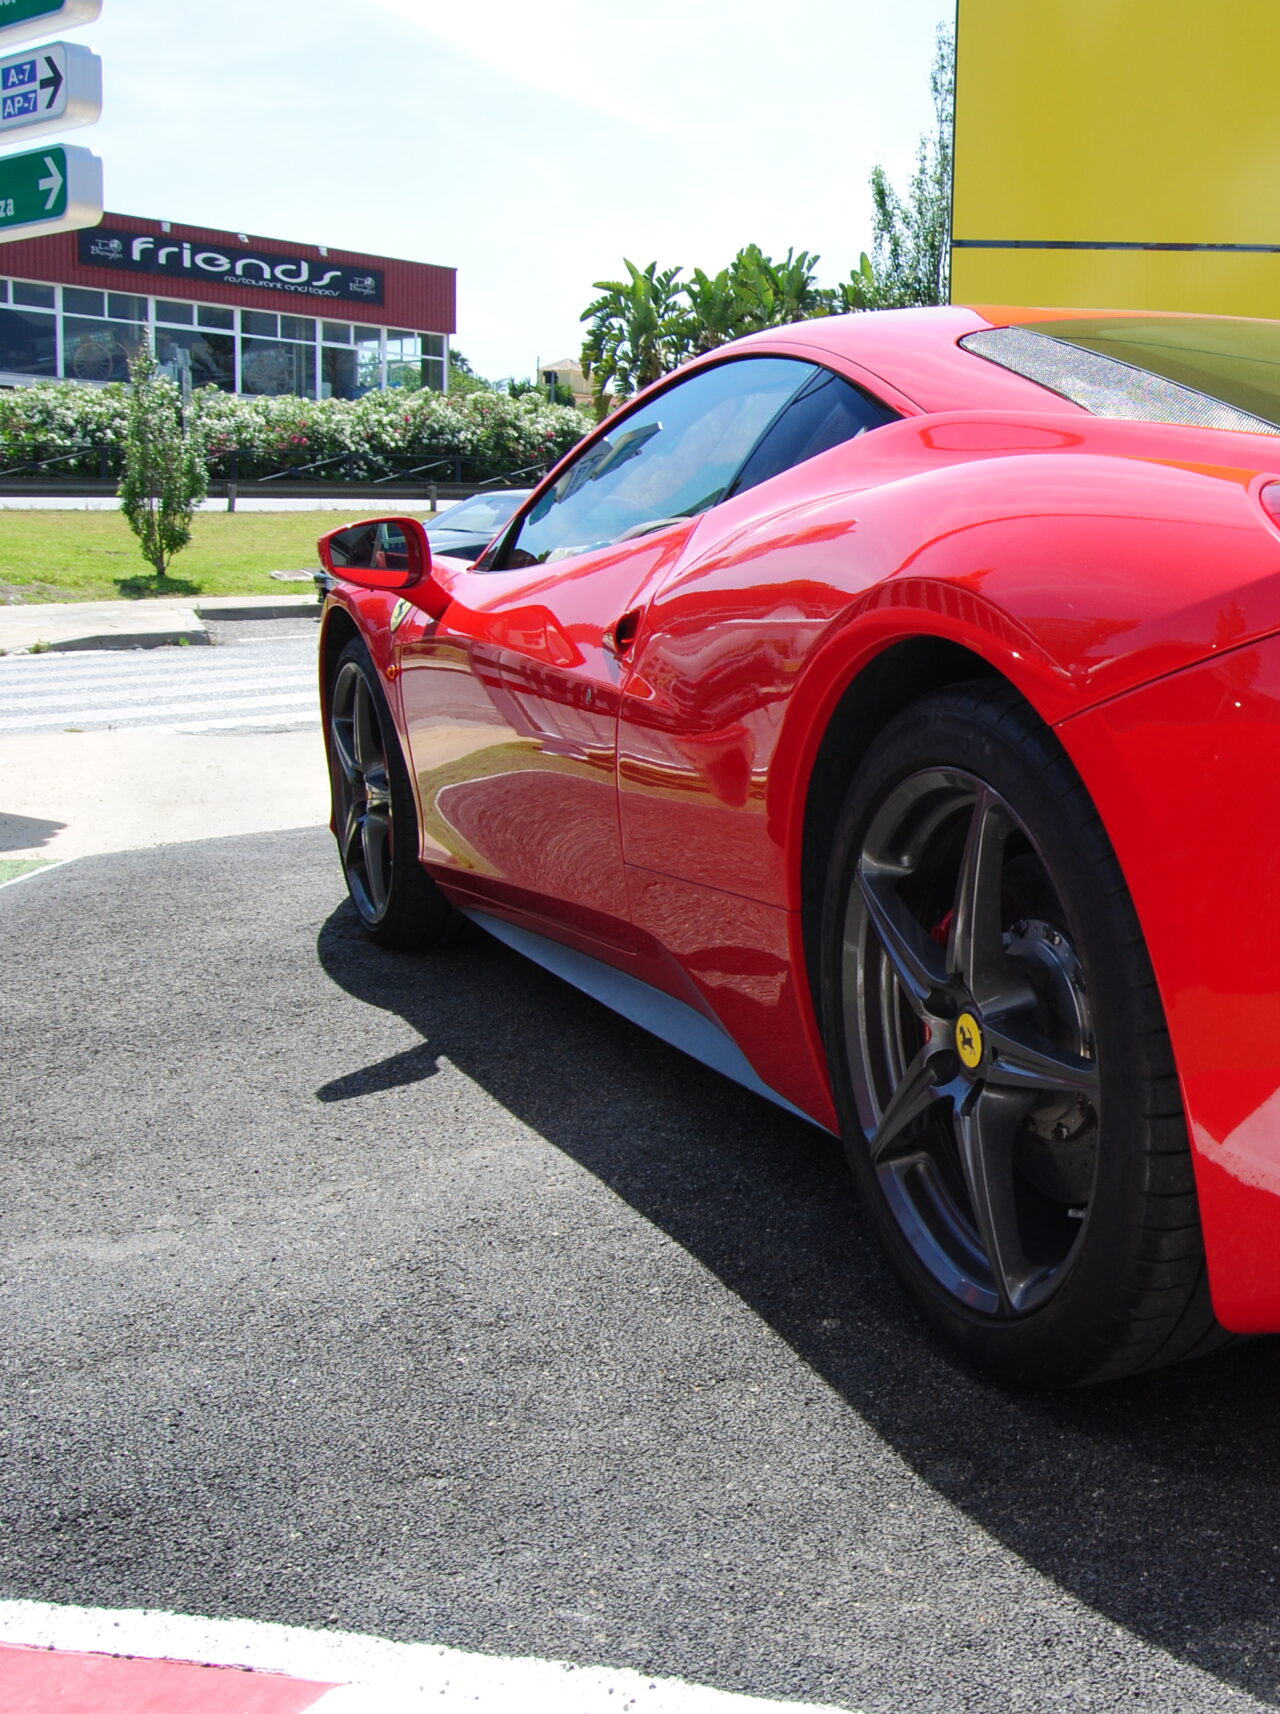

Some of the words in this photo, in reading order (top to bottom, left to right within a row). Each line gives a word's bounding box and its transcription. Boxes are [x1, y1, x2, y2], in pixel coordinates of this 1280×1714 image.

[7, 64, 31, 87] A-7
[3, 93, 37, 118] AP-7
[131, 237, 342, 286] friends
[224, 275, 284, 291] restaurant
[284, 284, 308, 294] and
[308, 285, 341, 297] tapas
